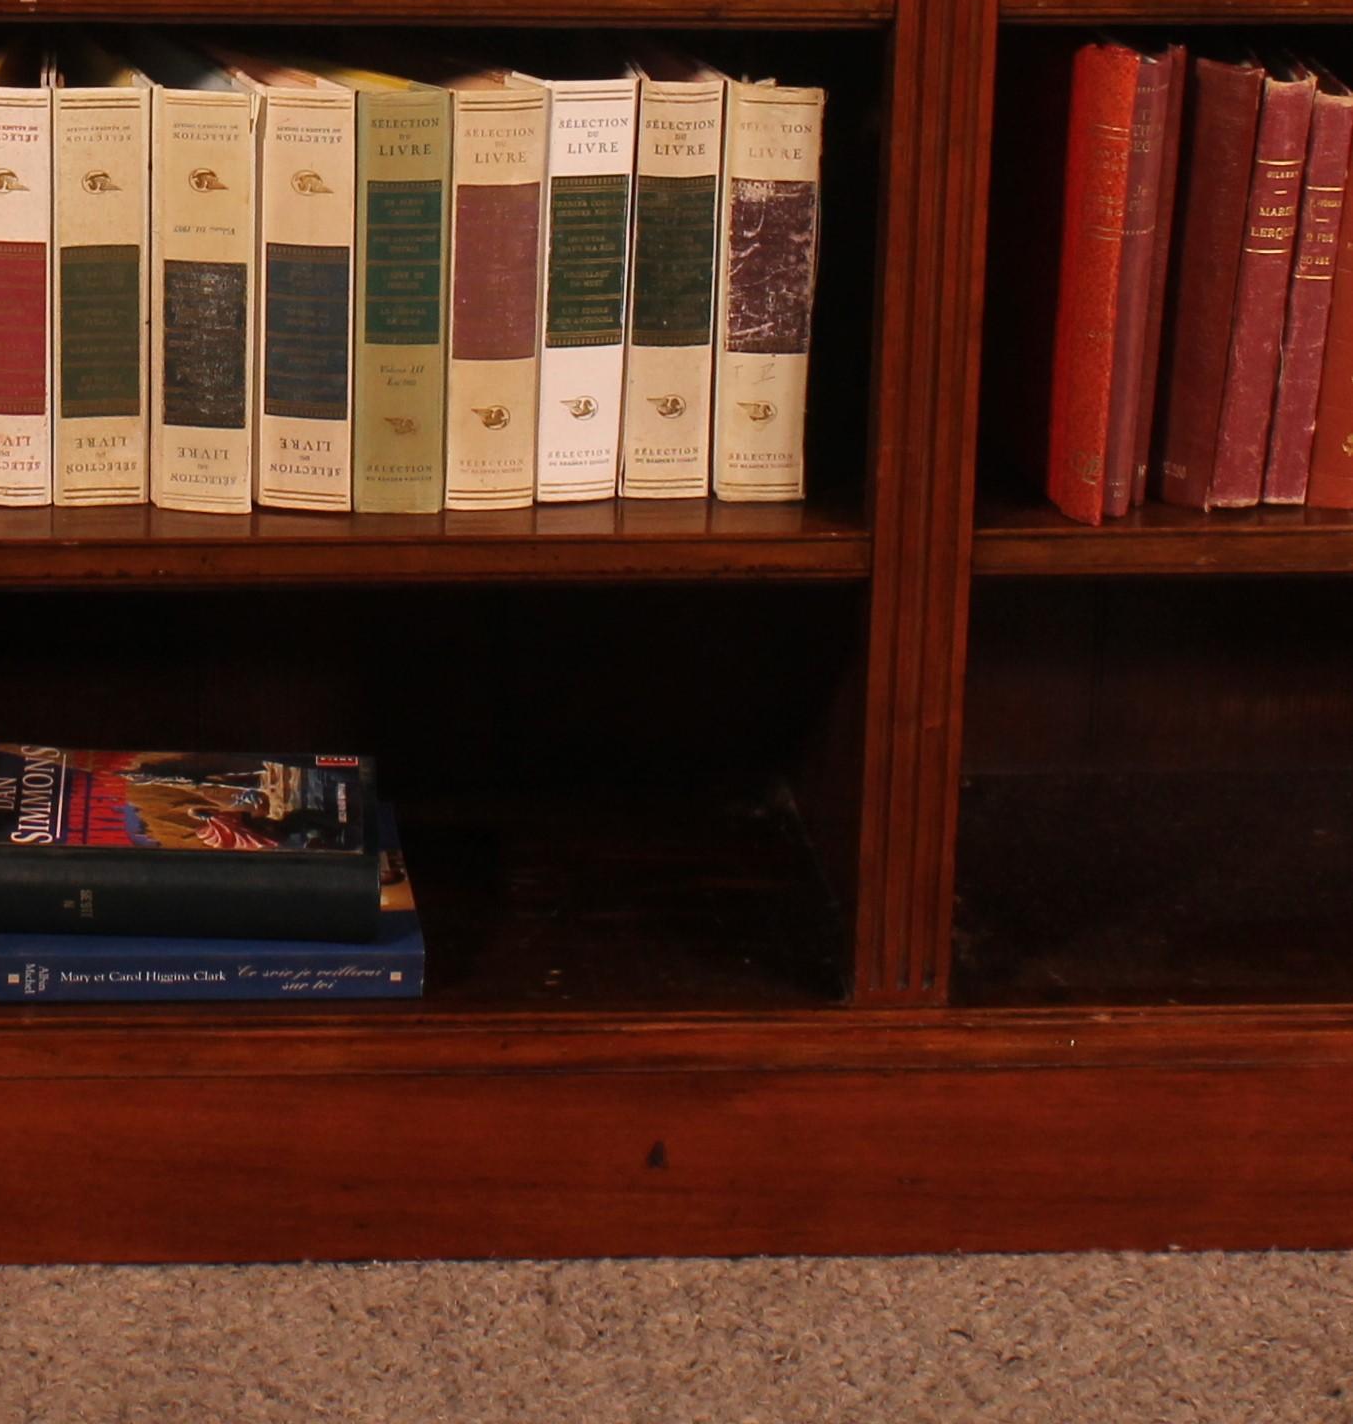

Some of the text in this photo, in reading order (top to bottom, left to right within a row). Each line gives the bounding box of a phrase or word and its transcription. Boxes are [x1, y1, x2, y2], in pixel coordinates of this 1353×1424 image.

[558, 117, 628, 129] SÉLECTION
[646, 118, 715, 131] SÉLECTION
[379, 144, 432, 156] LIVRE
[566, 142, 619, 154] LIVRE
[654, 143, 706, 156] LIVRE
[748, 148, 803, 160] LIVRE
[474, 152, 527, 164] LIVRE
[75, 435, 127, 449] LIVRE
[279, 437, 332, 451] LIVRE
[177, 447, 229, 460] LIVRE
[10, 745, 61, 844] SIMMONS
[60, 970, 227, 985] Mary et Carol Higgins Clark
[282, 979, 337, 992] sur toi
